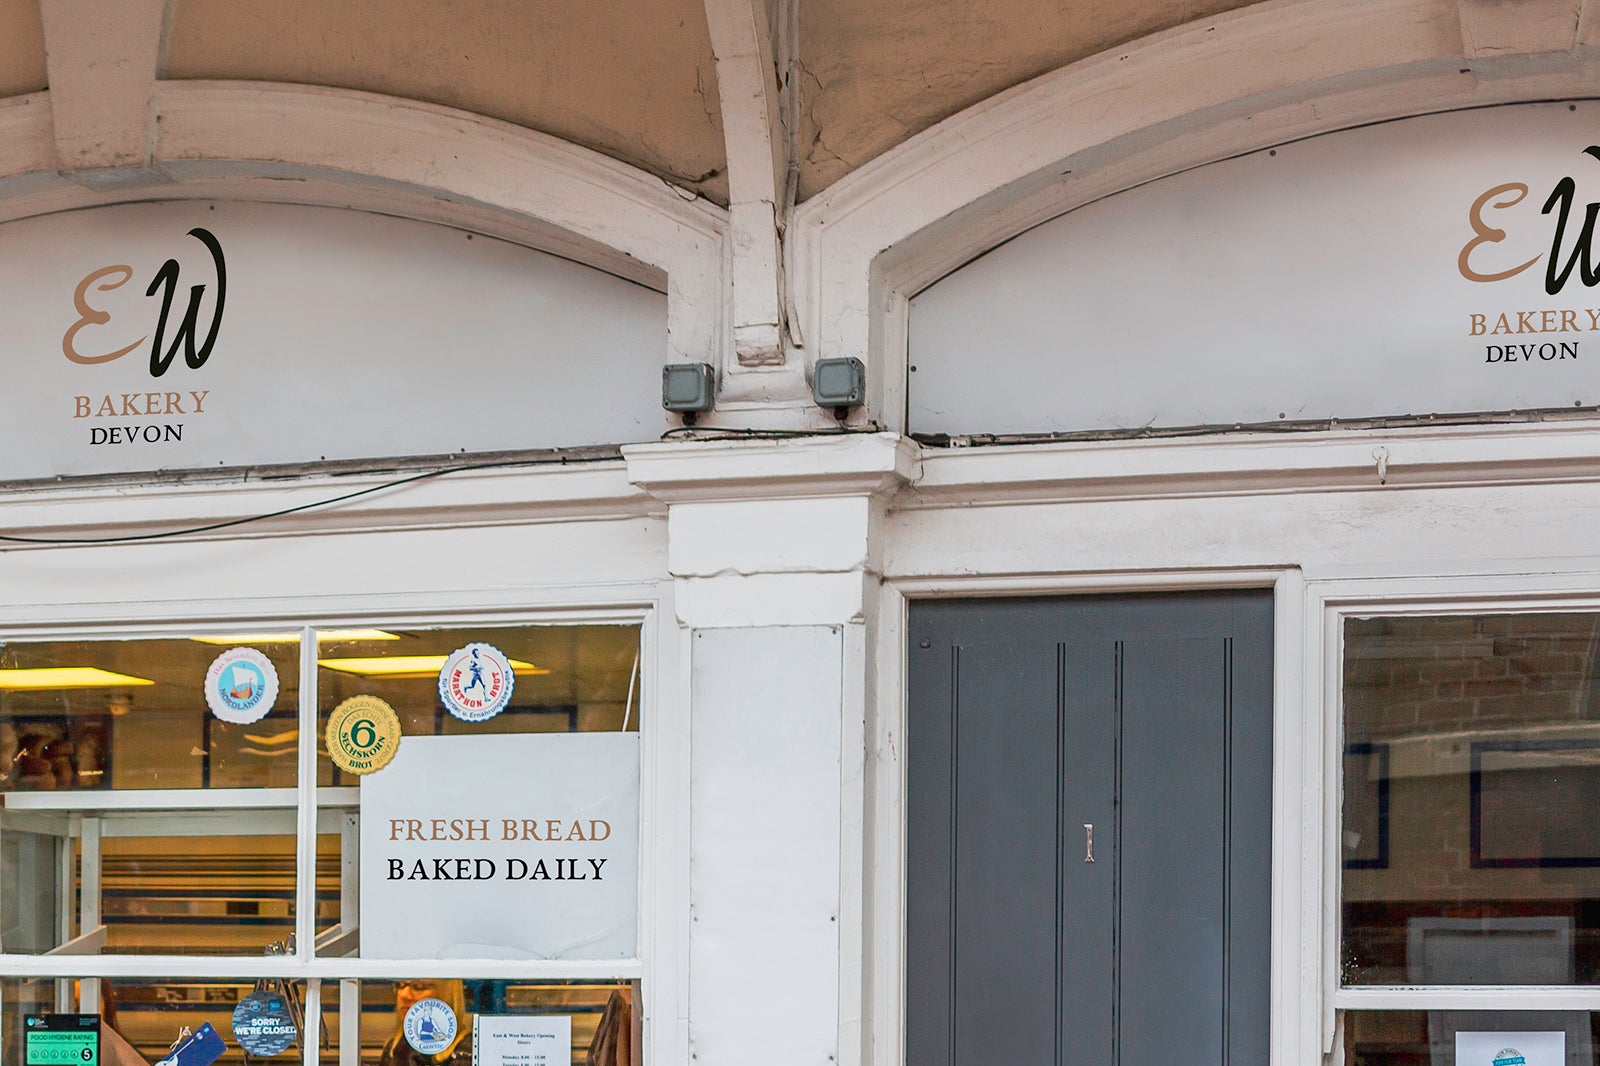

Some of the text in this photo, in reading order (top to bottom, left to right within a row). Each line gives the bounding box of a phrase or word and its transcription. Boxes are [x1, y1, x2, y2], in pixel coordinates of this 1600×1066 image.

[1468, 308, 1600, 336] BAKERY
[1484, 342, 1580, 363] DEVON
[73, 390, 210, 418] BAKERY
[89, 424, 184, 445] DEVON
[452, 669, 483, 708] MARATHON
[490, 671, 501, 698] BROT
[342, 731, 386, 758] SECHSKORN
[350, 719, 376, 748] 6
[348, 759, 373, 769] BROT
[388, 819, 611, 841] FRESH BREAD
[386, 858, 608, 881] BAKED DAILY
[410, 1001, 450, 1017] FAVOURITE
[235, 1026, 296, 1035] WE'RE CLOSED
[251, 1018, 281, 1026] SORRY
[407, 1018, 416, 1040] YOUR
[83, 1049, 91, 1060] 5
